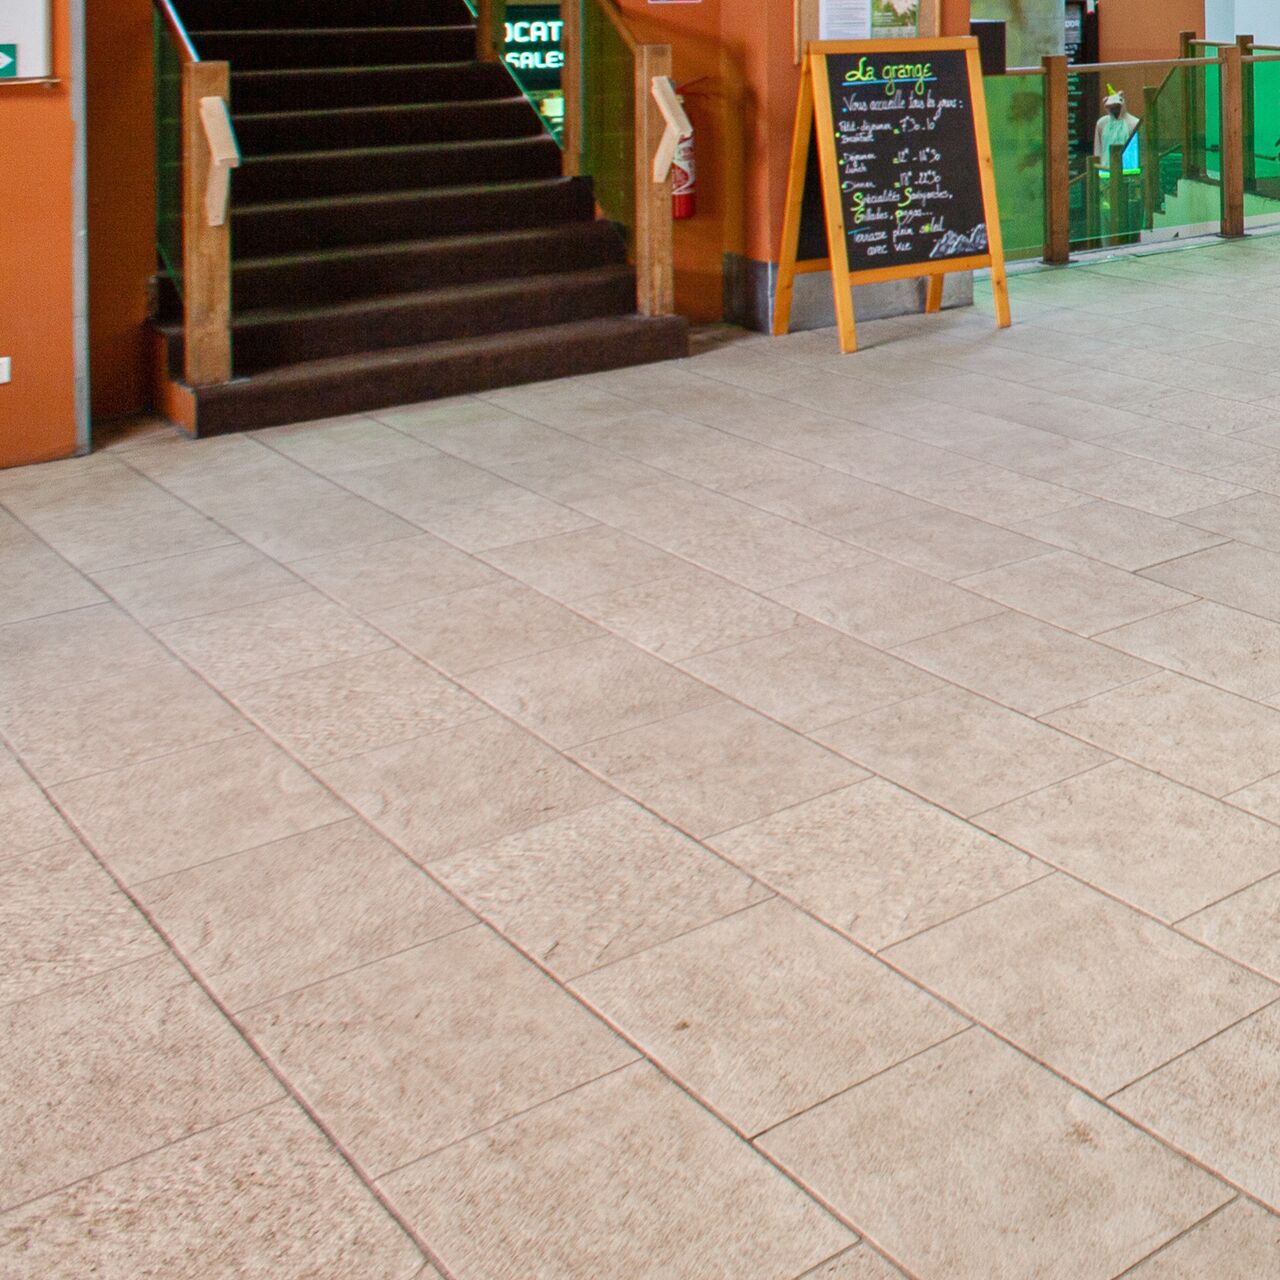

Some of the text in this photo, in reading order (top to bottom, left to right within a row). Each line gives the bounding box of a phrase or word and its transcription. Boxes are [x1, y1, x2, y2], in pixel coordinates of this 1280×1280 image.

[845, 56, 933, 95] La grange
[843, 93, 867, 111] Vous
[867, 241, 913, 256] avec vue
